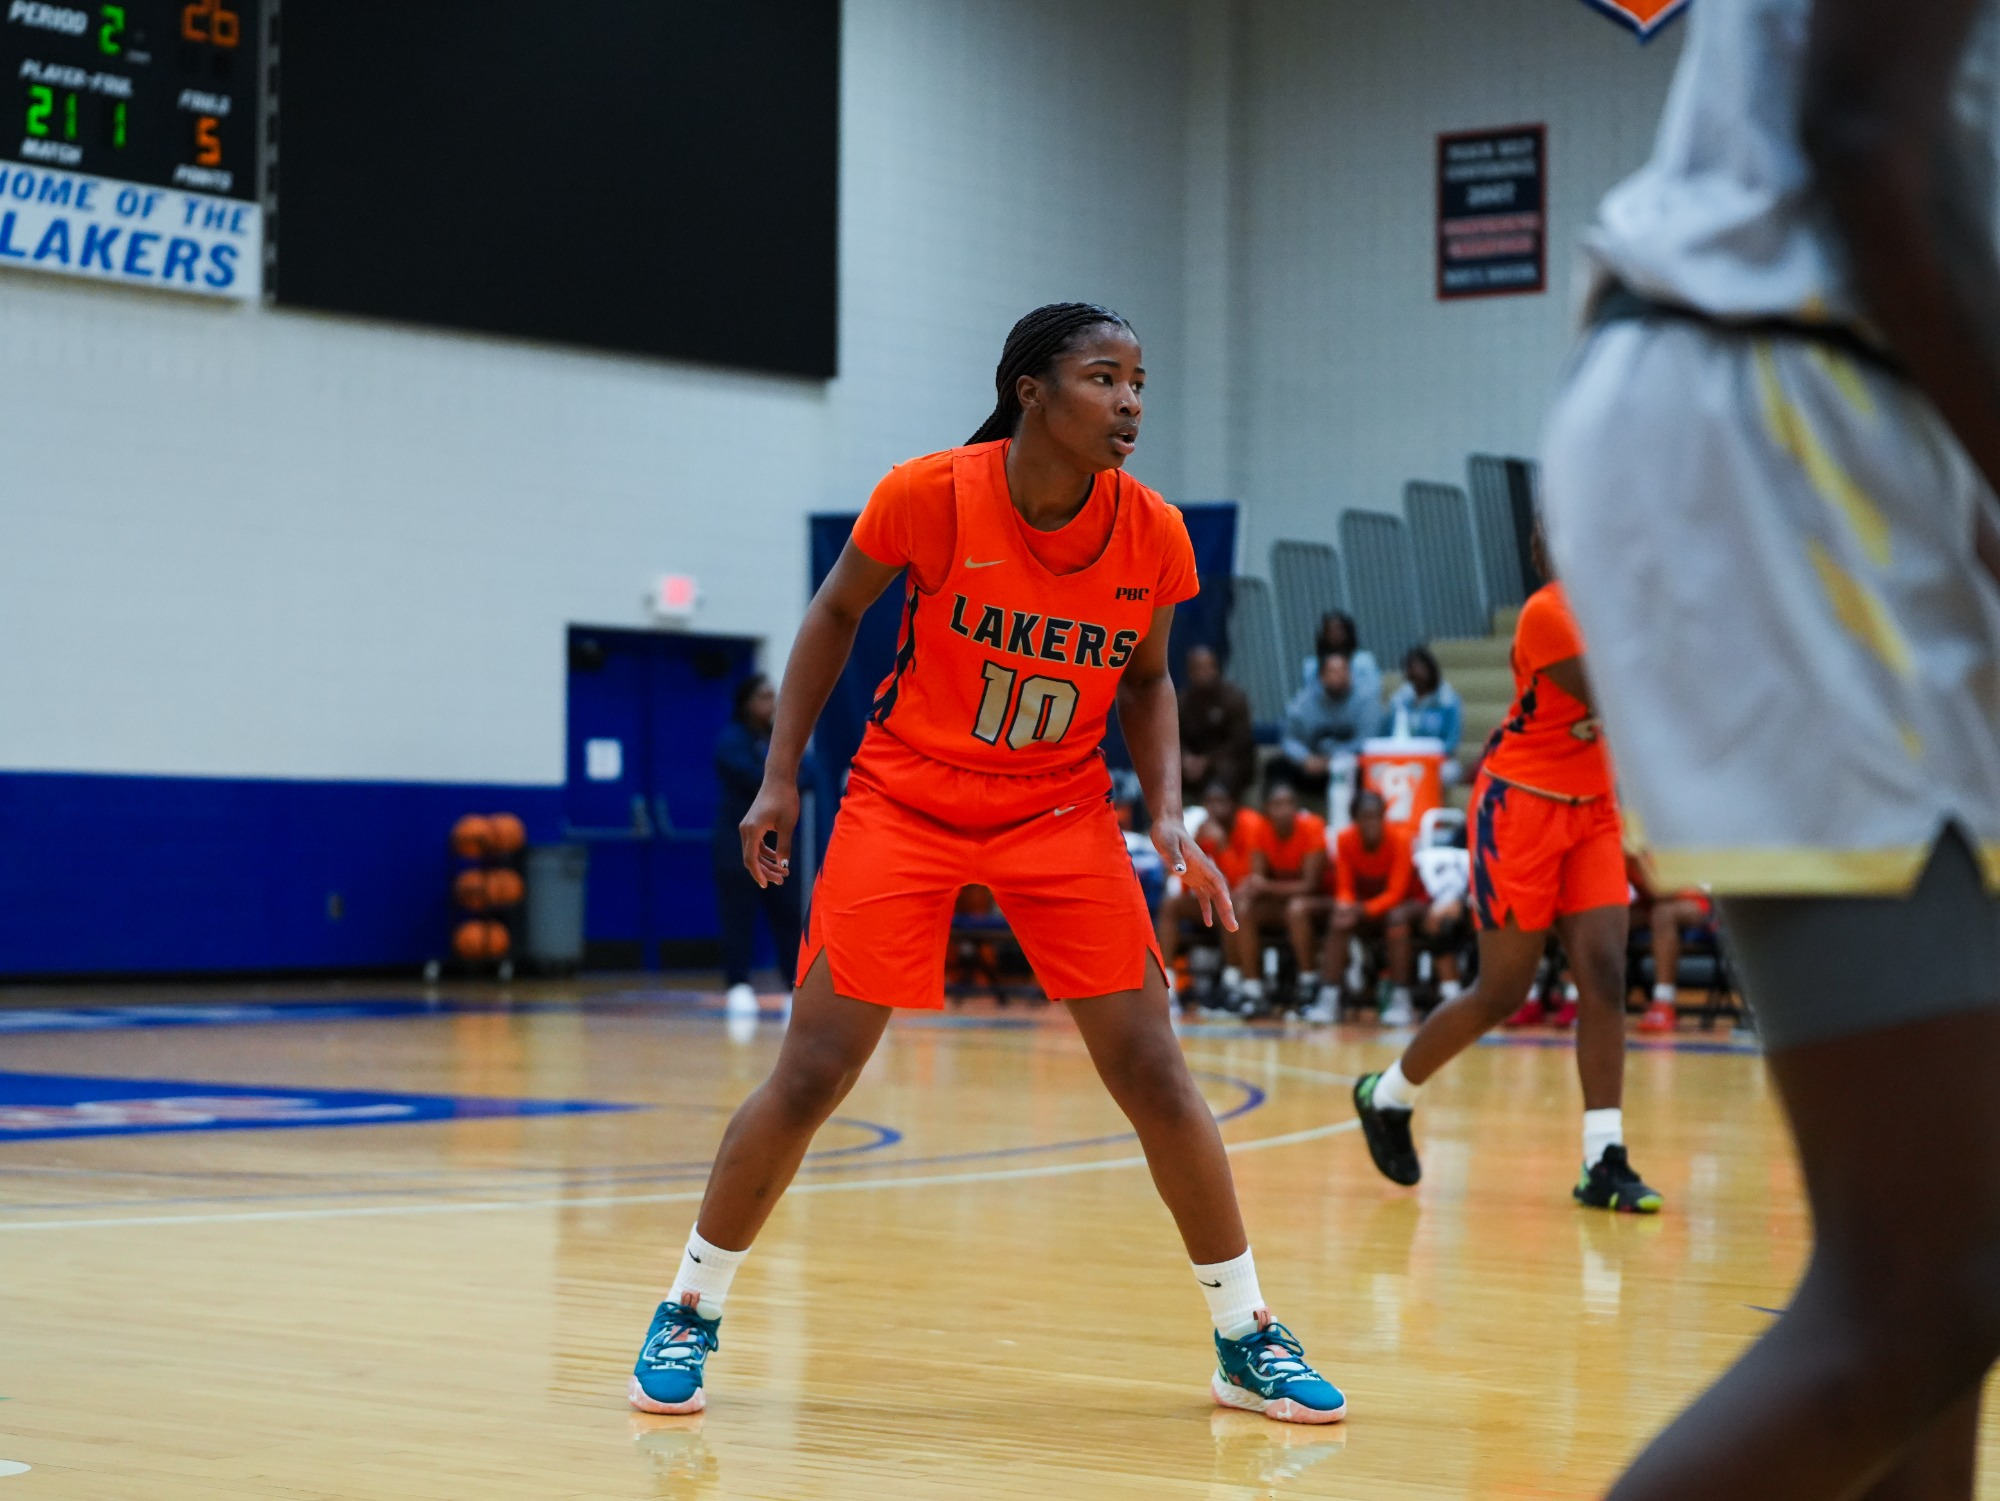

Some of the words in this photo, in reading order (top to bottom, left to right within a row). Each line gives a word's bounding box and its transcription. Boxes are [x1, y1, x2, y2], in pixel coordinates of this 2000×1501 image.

[8, 0, 88, 35] PERIOD
[100, 4, 125, 54] 2
[26, 84, 78, 141] 21
[196, 116, 222, 166] 5
[116, 187, 165, 219] OF
[184, 197, 250, 236] THE
[0, 210, 239, 288] LAKERS
[1115, 586, 1150, 602] PBC
[949, 592, 1140, 669] LAKERS
[970, 658, 1081, 751] 10
